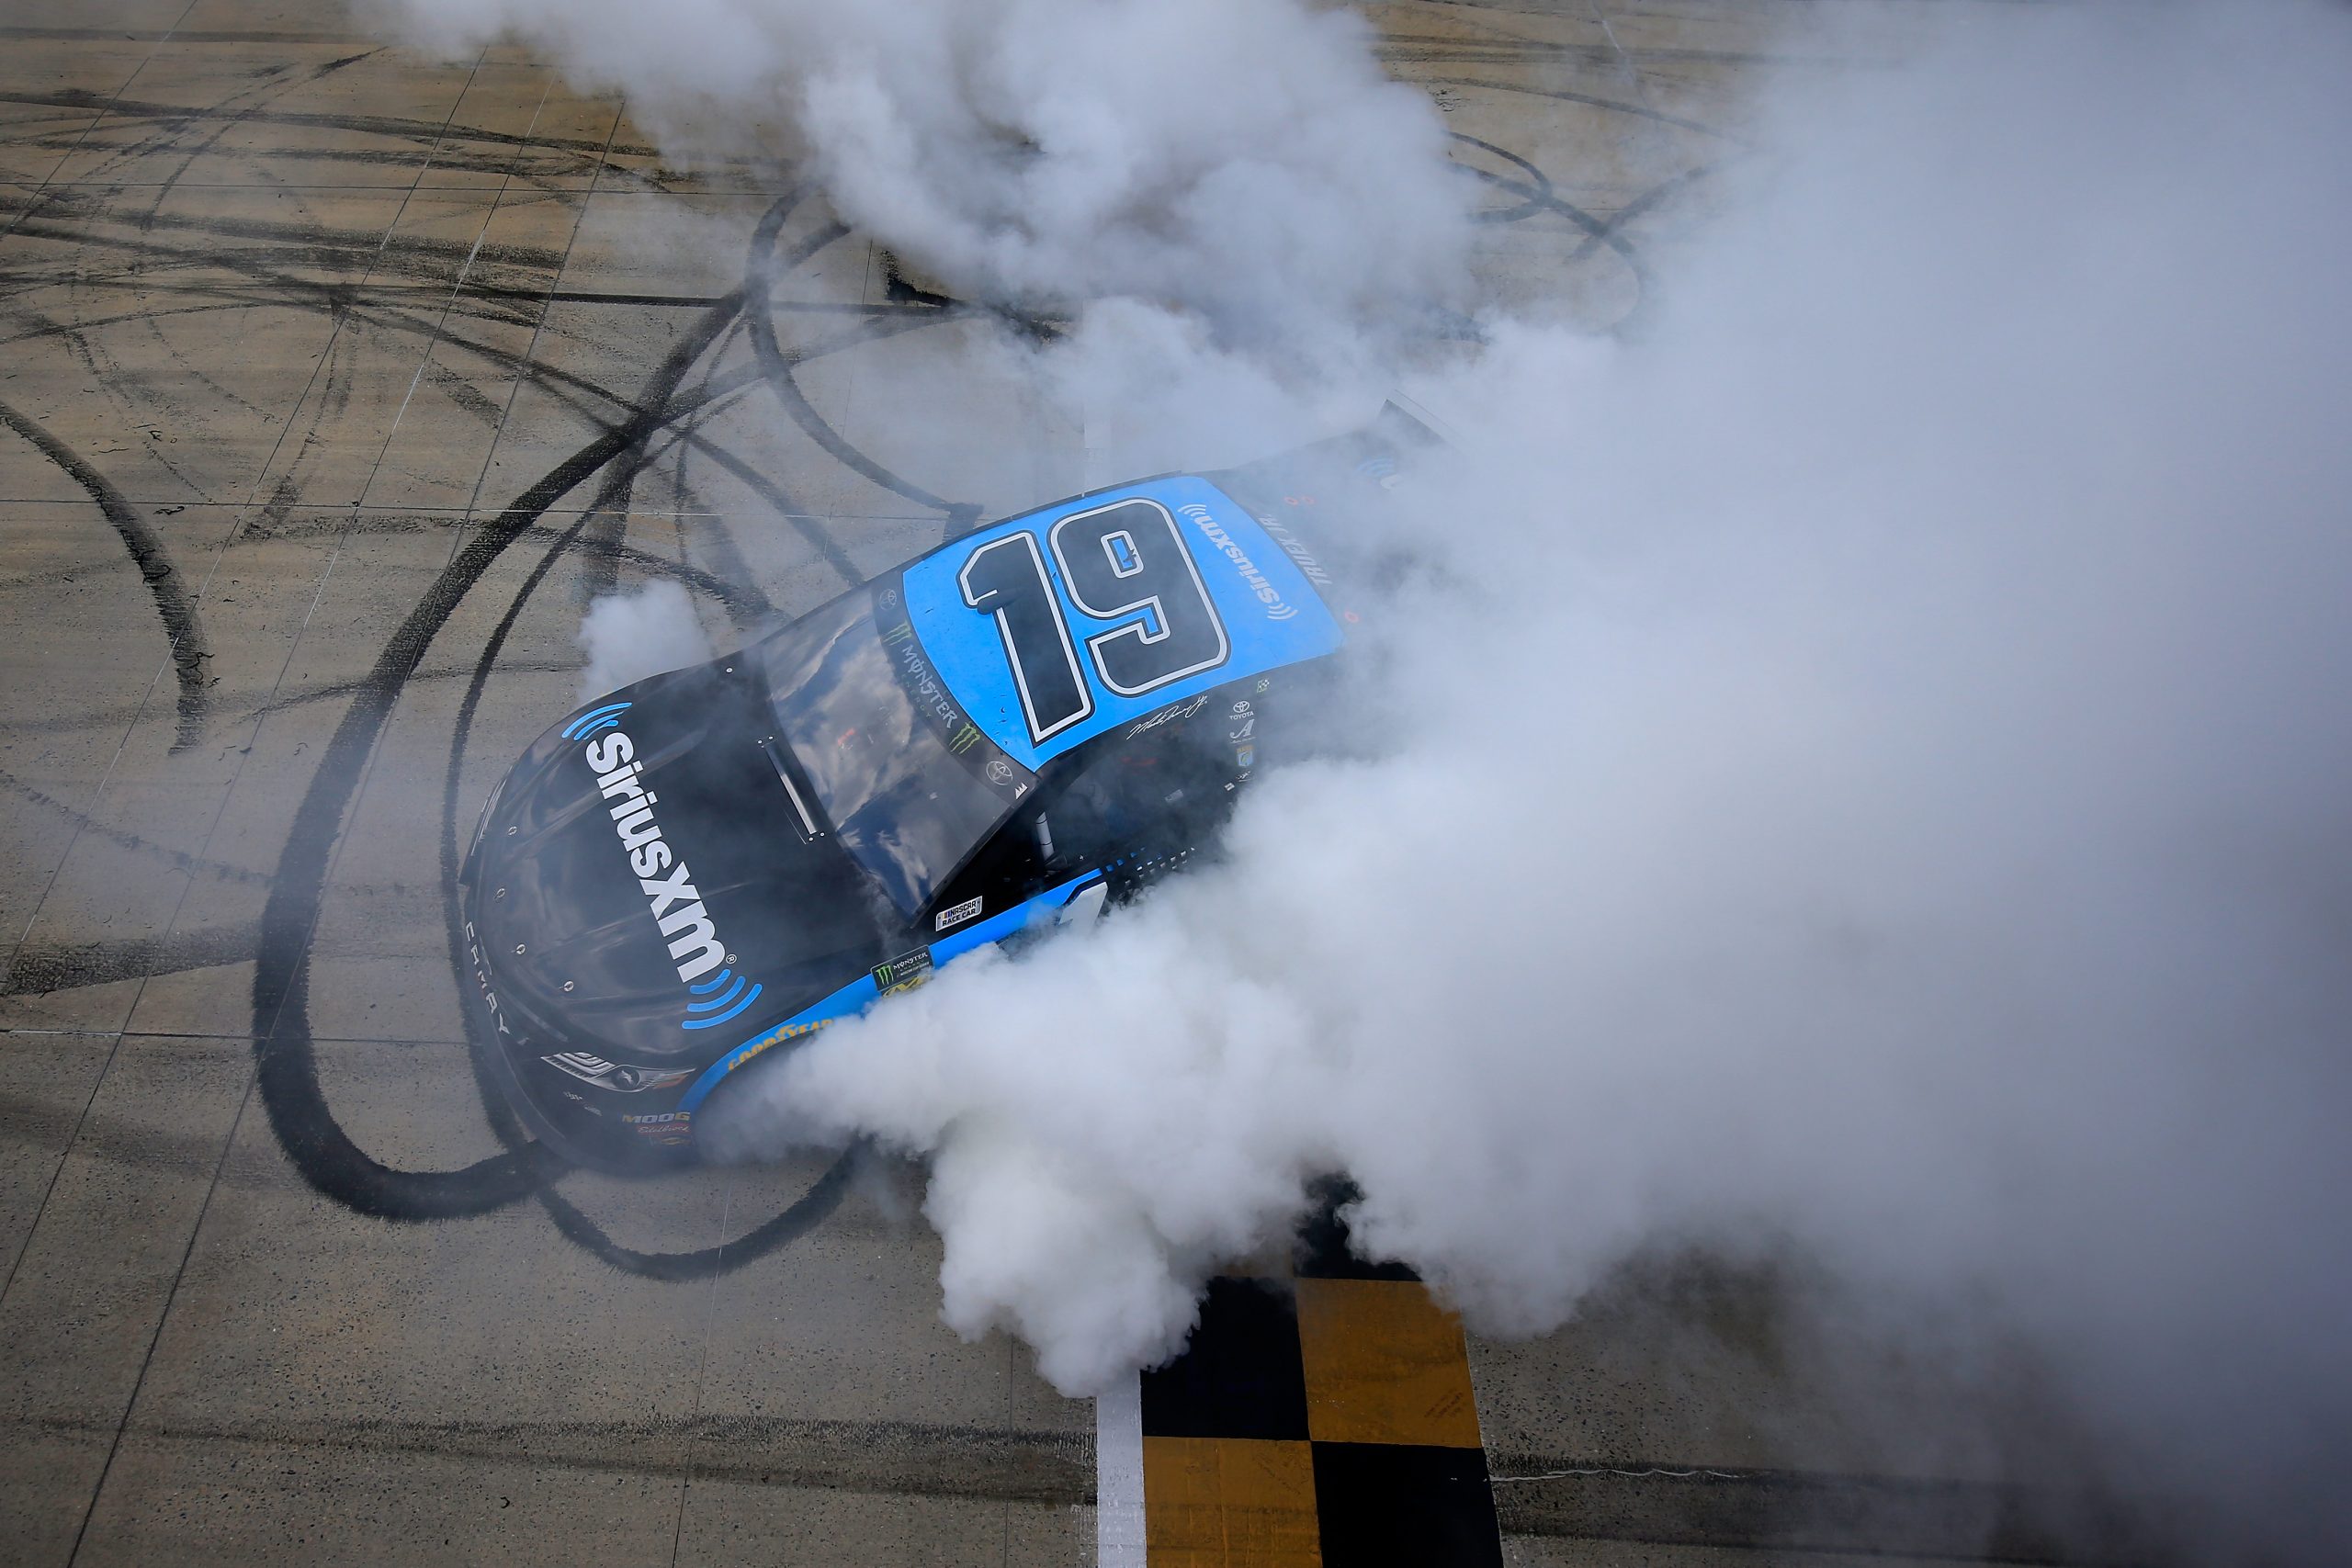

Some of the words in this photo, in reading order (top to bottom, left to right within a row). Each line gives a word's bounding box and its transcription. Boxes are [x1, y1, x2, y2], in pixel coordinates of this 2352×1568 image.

[1277, 537, 1332, 585] TRUEX
[956, 497, 1231, 748] 19
[902, 645, 958, 728] MONSTER
[1229, 711, 1254, 720] TOYOTA
[942, 915, 960, 927] RACE
[962, 908, 976, 919] CAR
[949, 900, 977, 918] NASCAR
[893, 952, 928, 970] MONSTER
[466, 921, 510, 1034] CAMRY
[621, 1111, 690, 1123] MOOG
